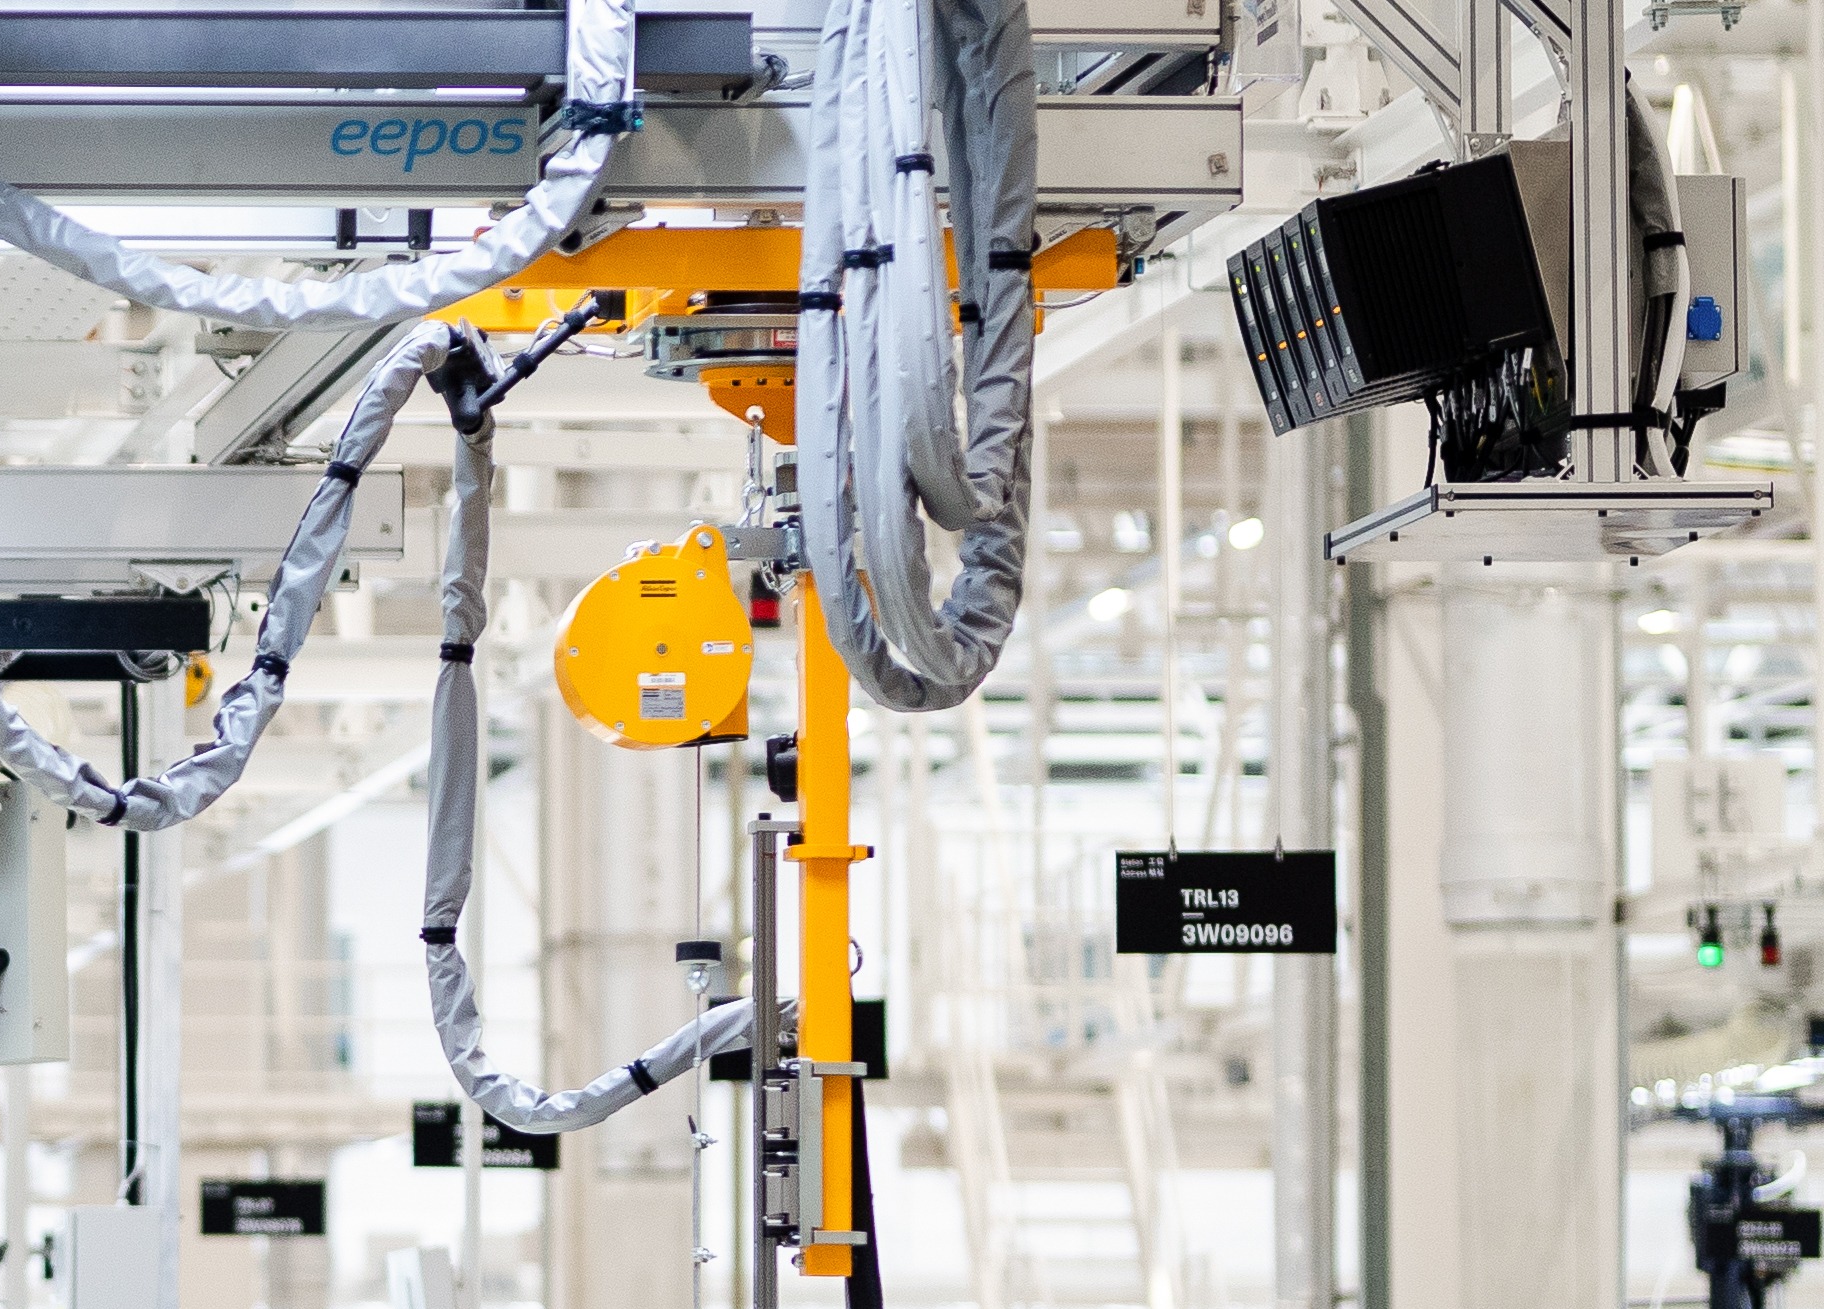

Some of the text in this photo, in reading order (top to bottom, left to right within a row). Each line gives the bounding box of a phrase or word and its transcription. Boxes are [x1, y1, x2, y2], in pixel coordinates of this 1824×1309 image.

[330, 118, 526, 173] eepos
[1180, 889, 1240, 908] TRL13
[1181, 923, 1294, 946] 3W09096
